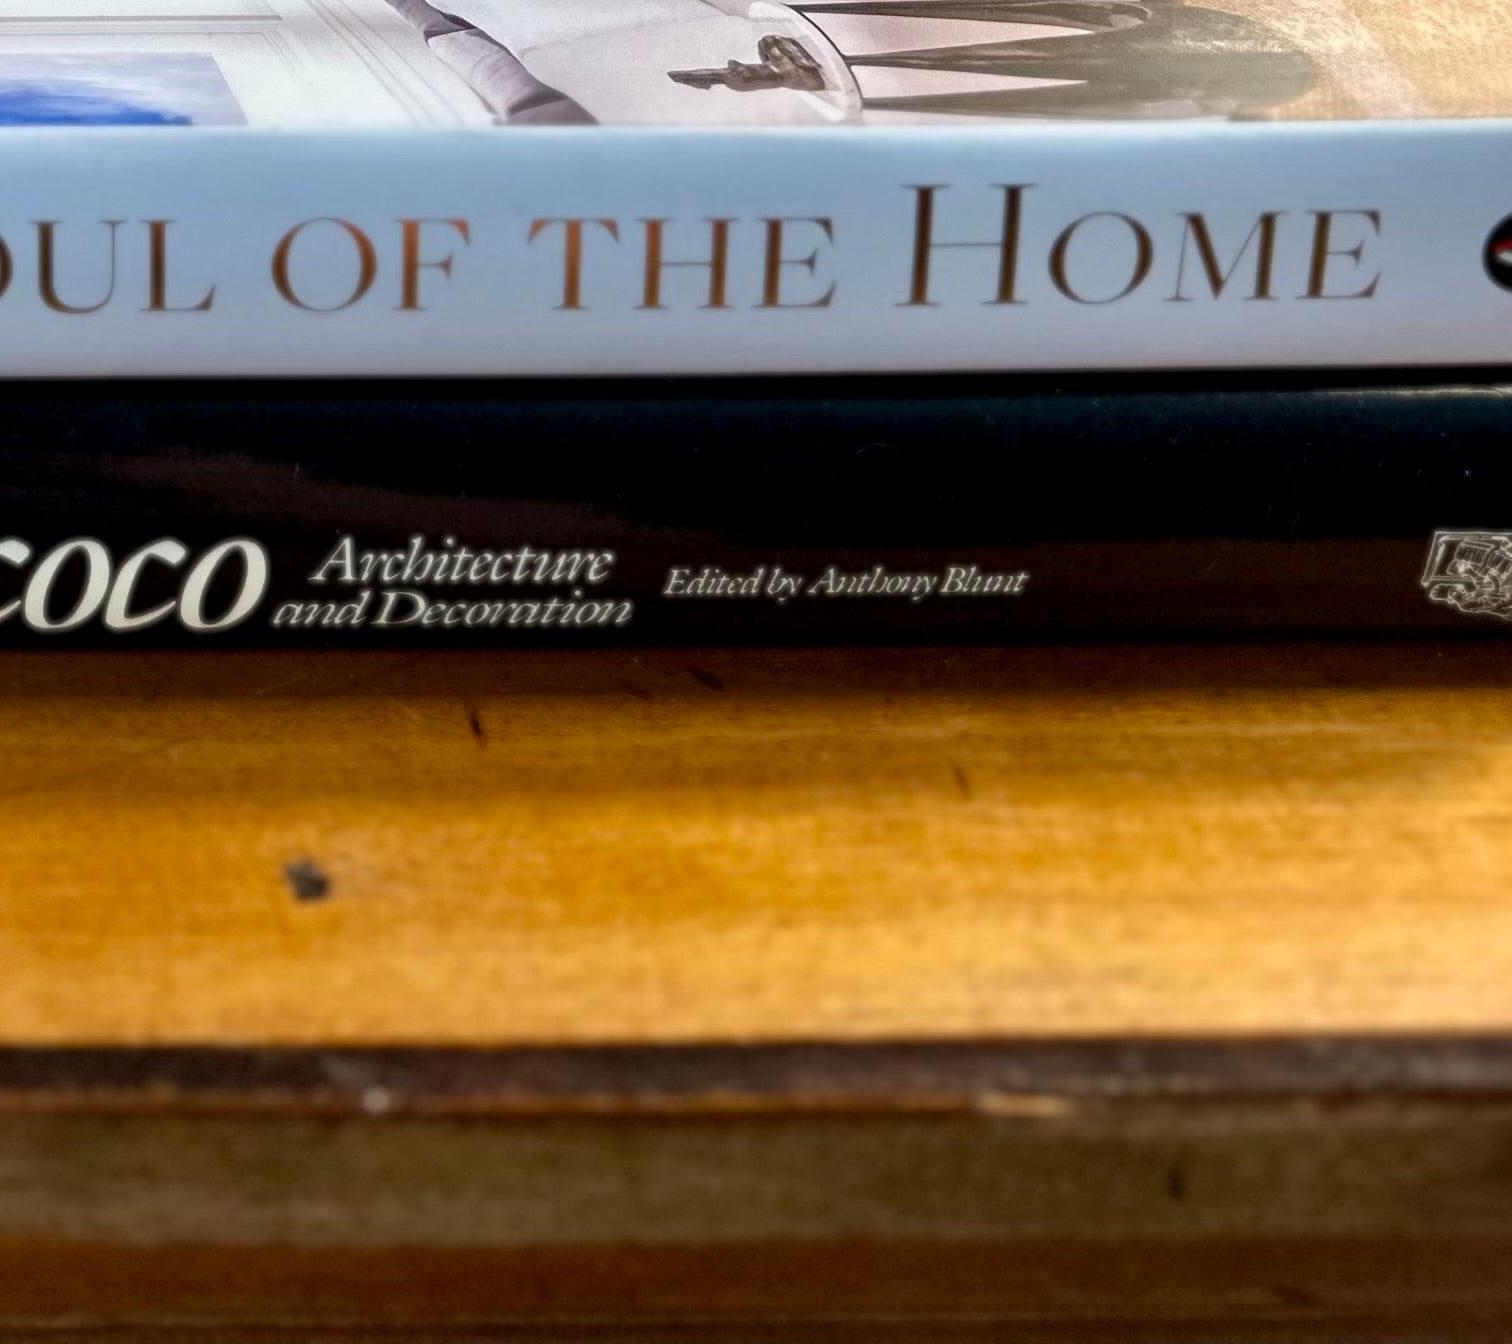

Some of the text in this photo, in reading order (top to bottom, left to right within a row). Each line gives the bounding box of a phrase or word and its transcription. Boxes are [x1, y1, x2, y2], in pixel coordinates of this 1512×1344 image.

[271, 218, 471, 313] OF
[528, 215, 837, 311] THE
[894, 182, 1382, 307] HOME
[308, 535, 615, 584] Architecture
[663, 565, 1029, 602] Edited by Anthony Blunt
[272, 589, 632, 626] and Decoration
